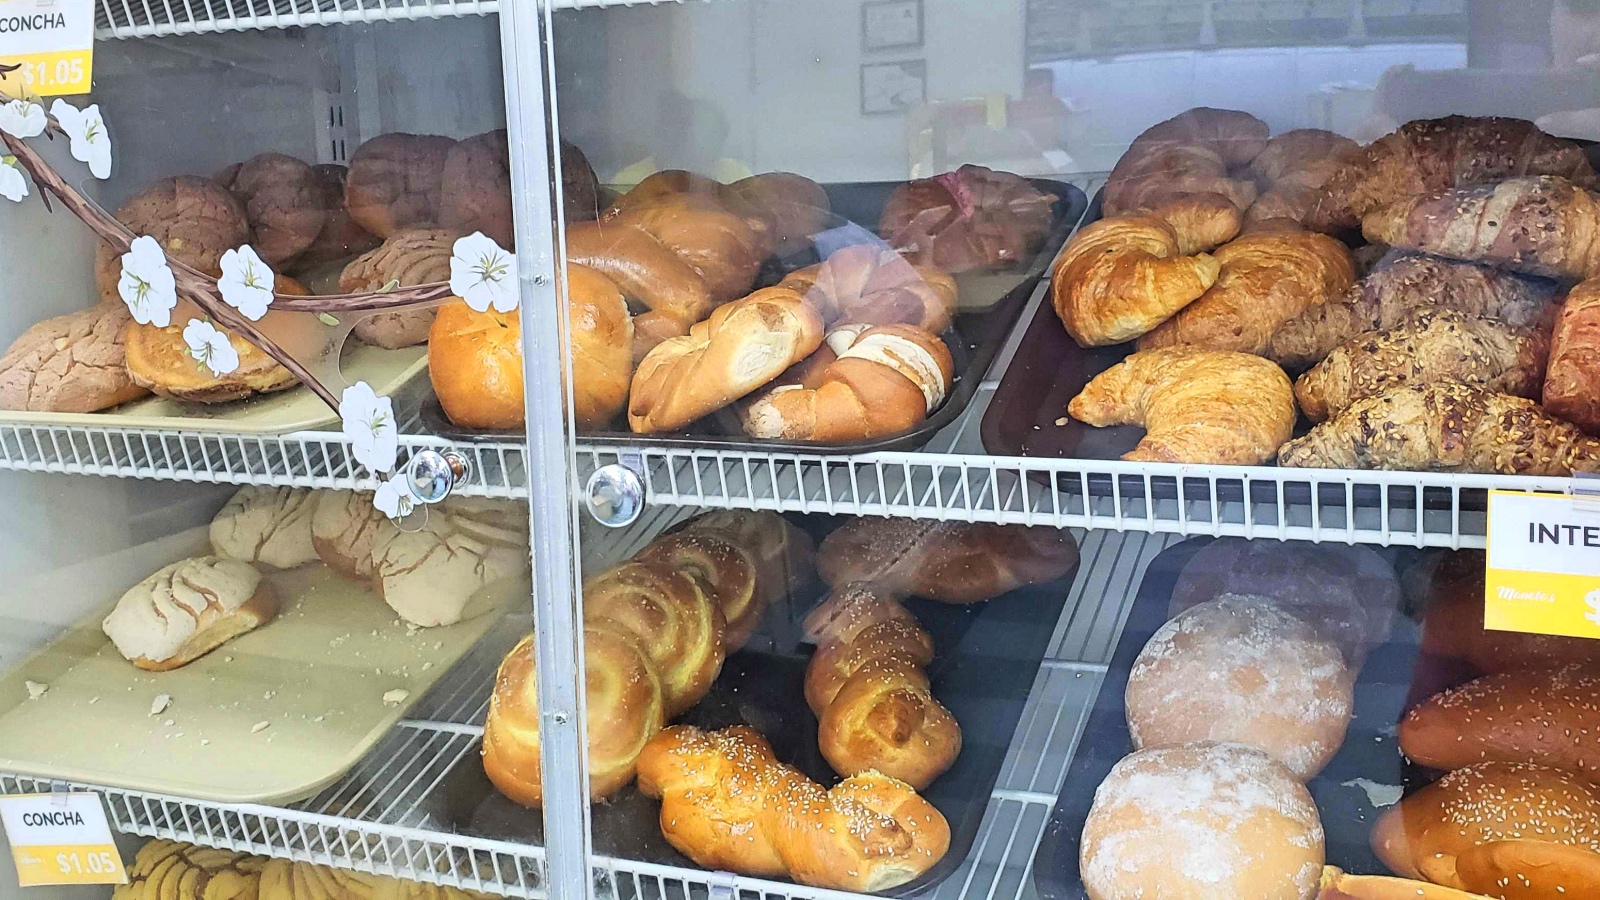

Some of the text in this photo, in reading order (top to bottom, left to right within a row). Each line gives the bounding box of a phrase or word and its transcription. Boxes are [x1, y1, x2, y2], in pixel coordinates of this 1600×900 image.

[0, 12, 66, 33] CONCHA
[22, 57, 84, 86] $1.05
[1529, 522, 1600, 547] INTE
[22, 811, 86, 827] CONCHA
[56, 851, 116, 876] $1.05
